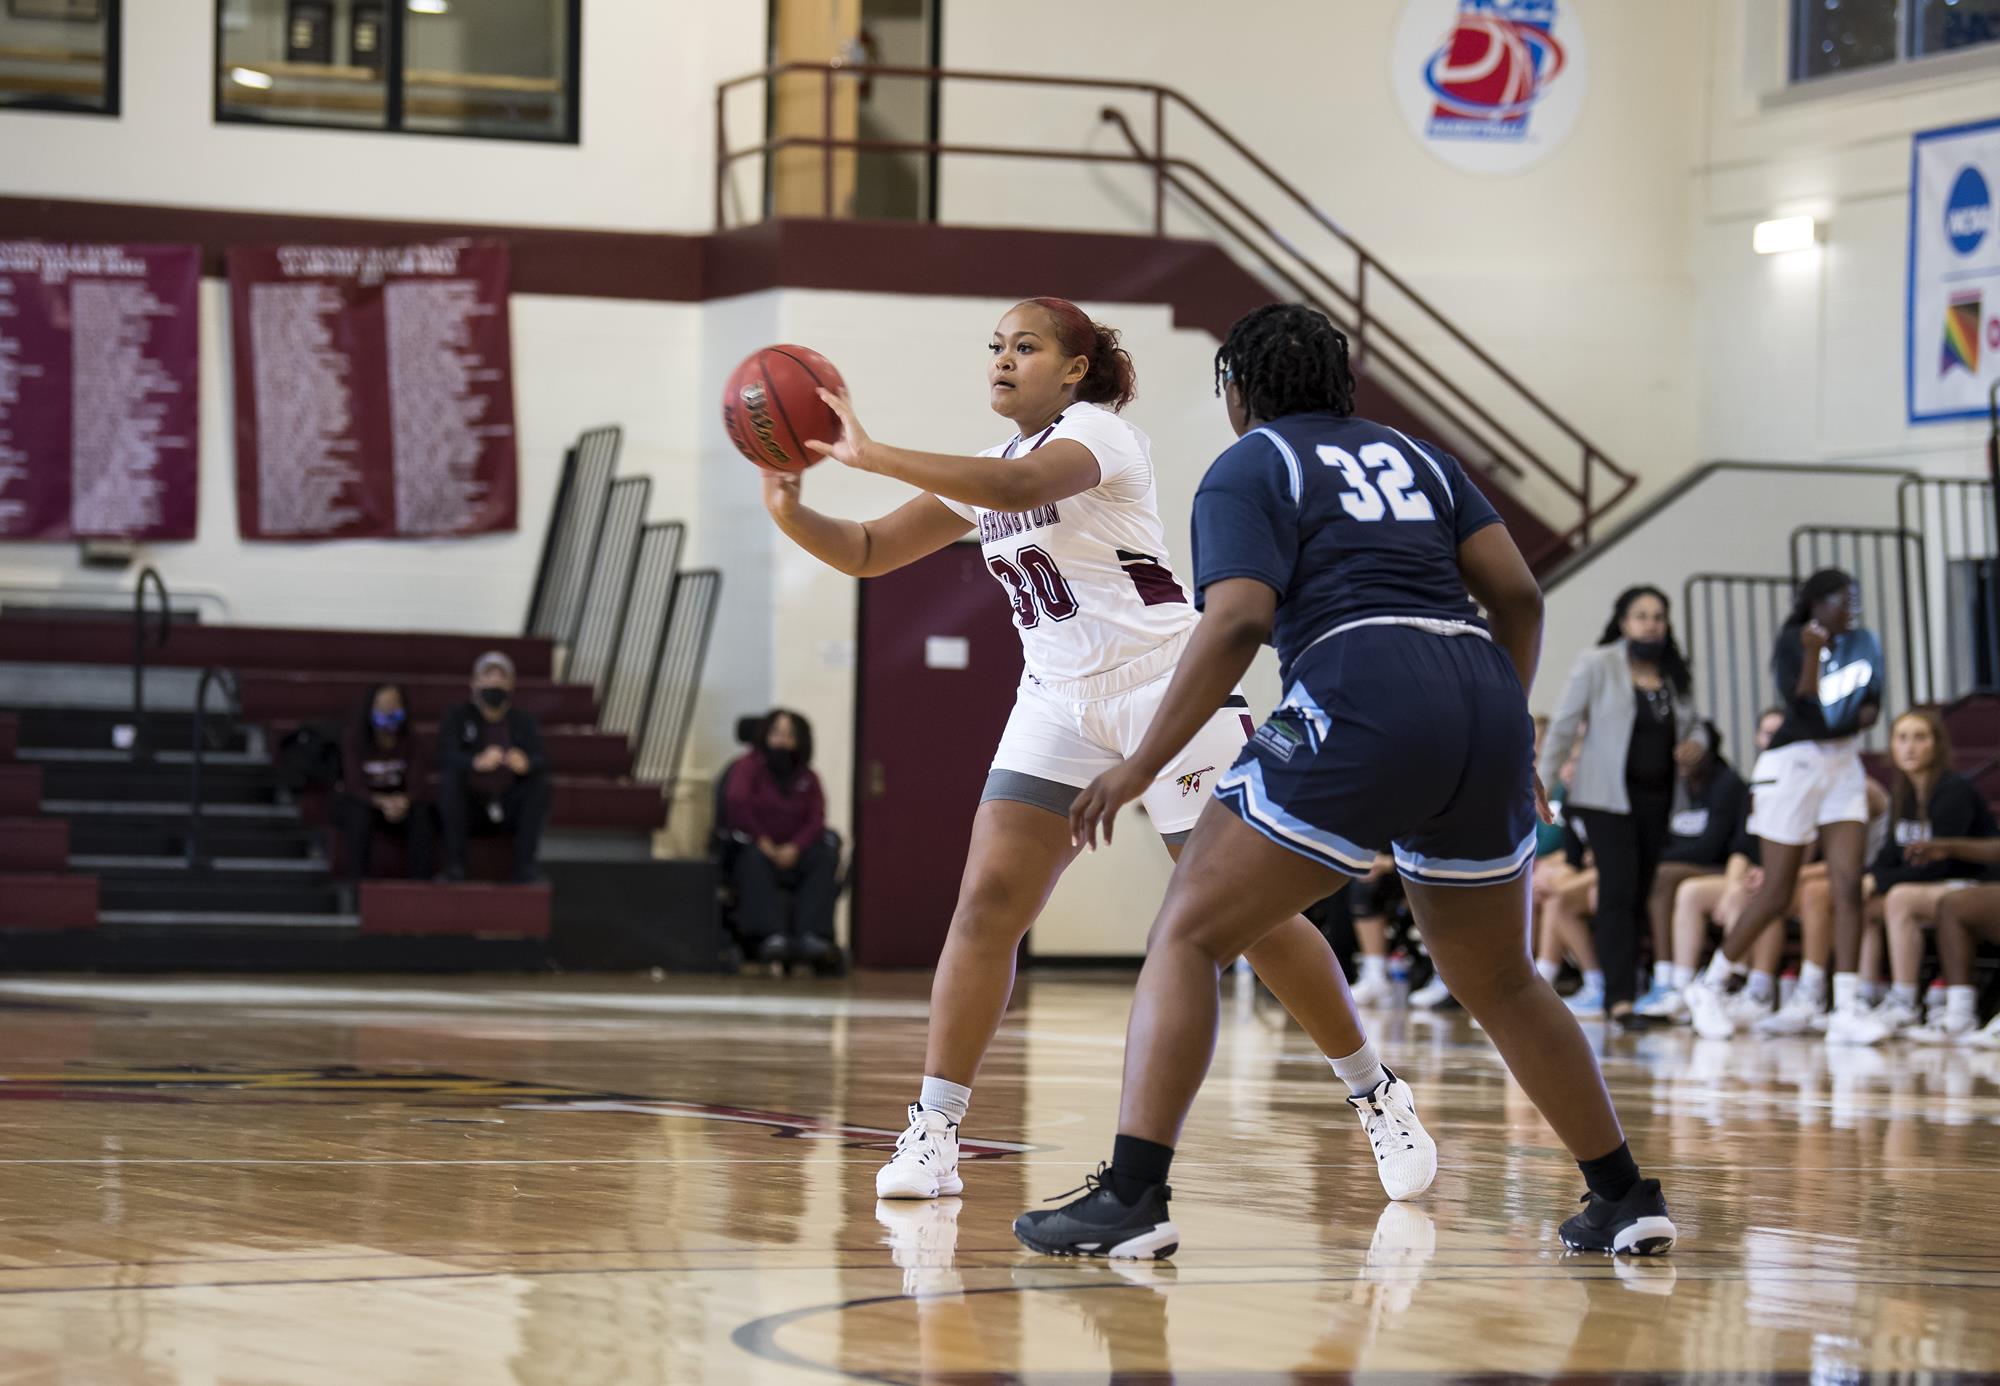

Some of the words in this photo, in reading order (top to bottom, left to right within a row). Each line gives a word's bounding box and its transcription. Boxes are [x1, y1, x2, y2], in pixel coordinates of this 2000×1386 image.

[1315, 441, 1436, 521] 32
[978, 502, 1061, 545] SHINGTON
[987, 544, 1079, 629] 30
